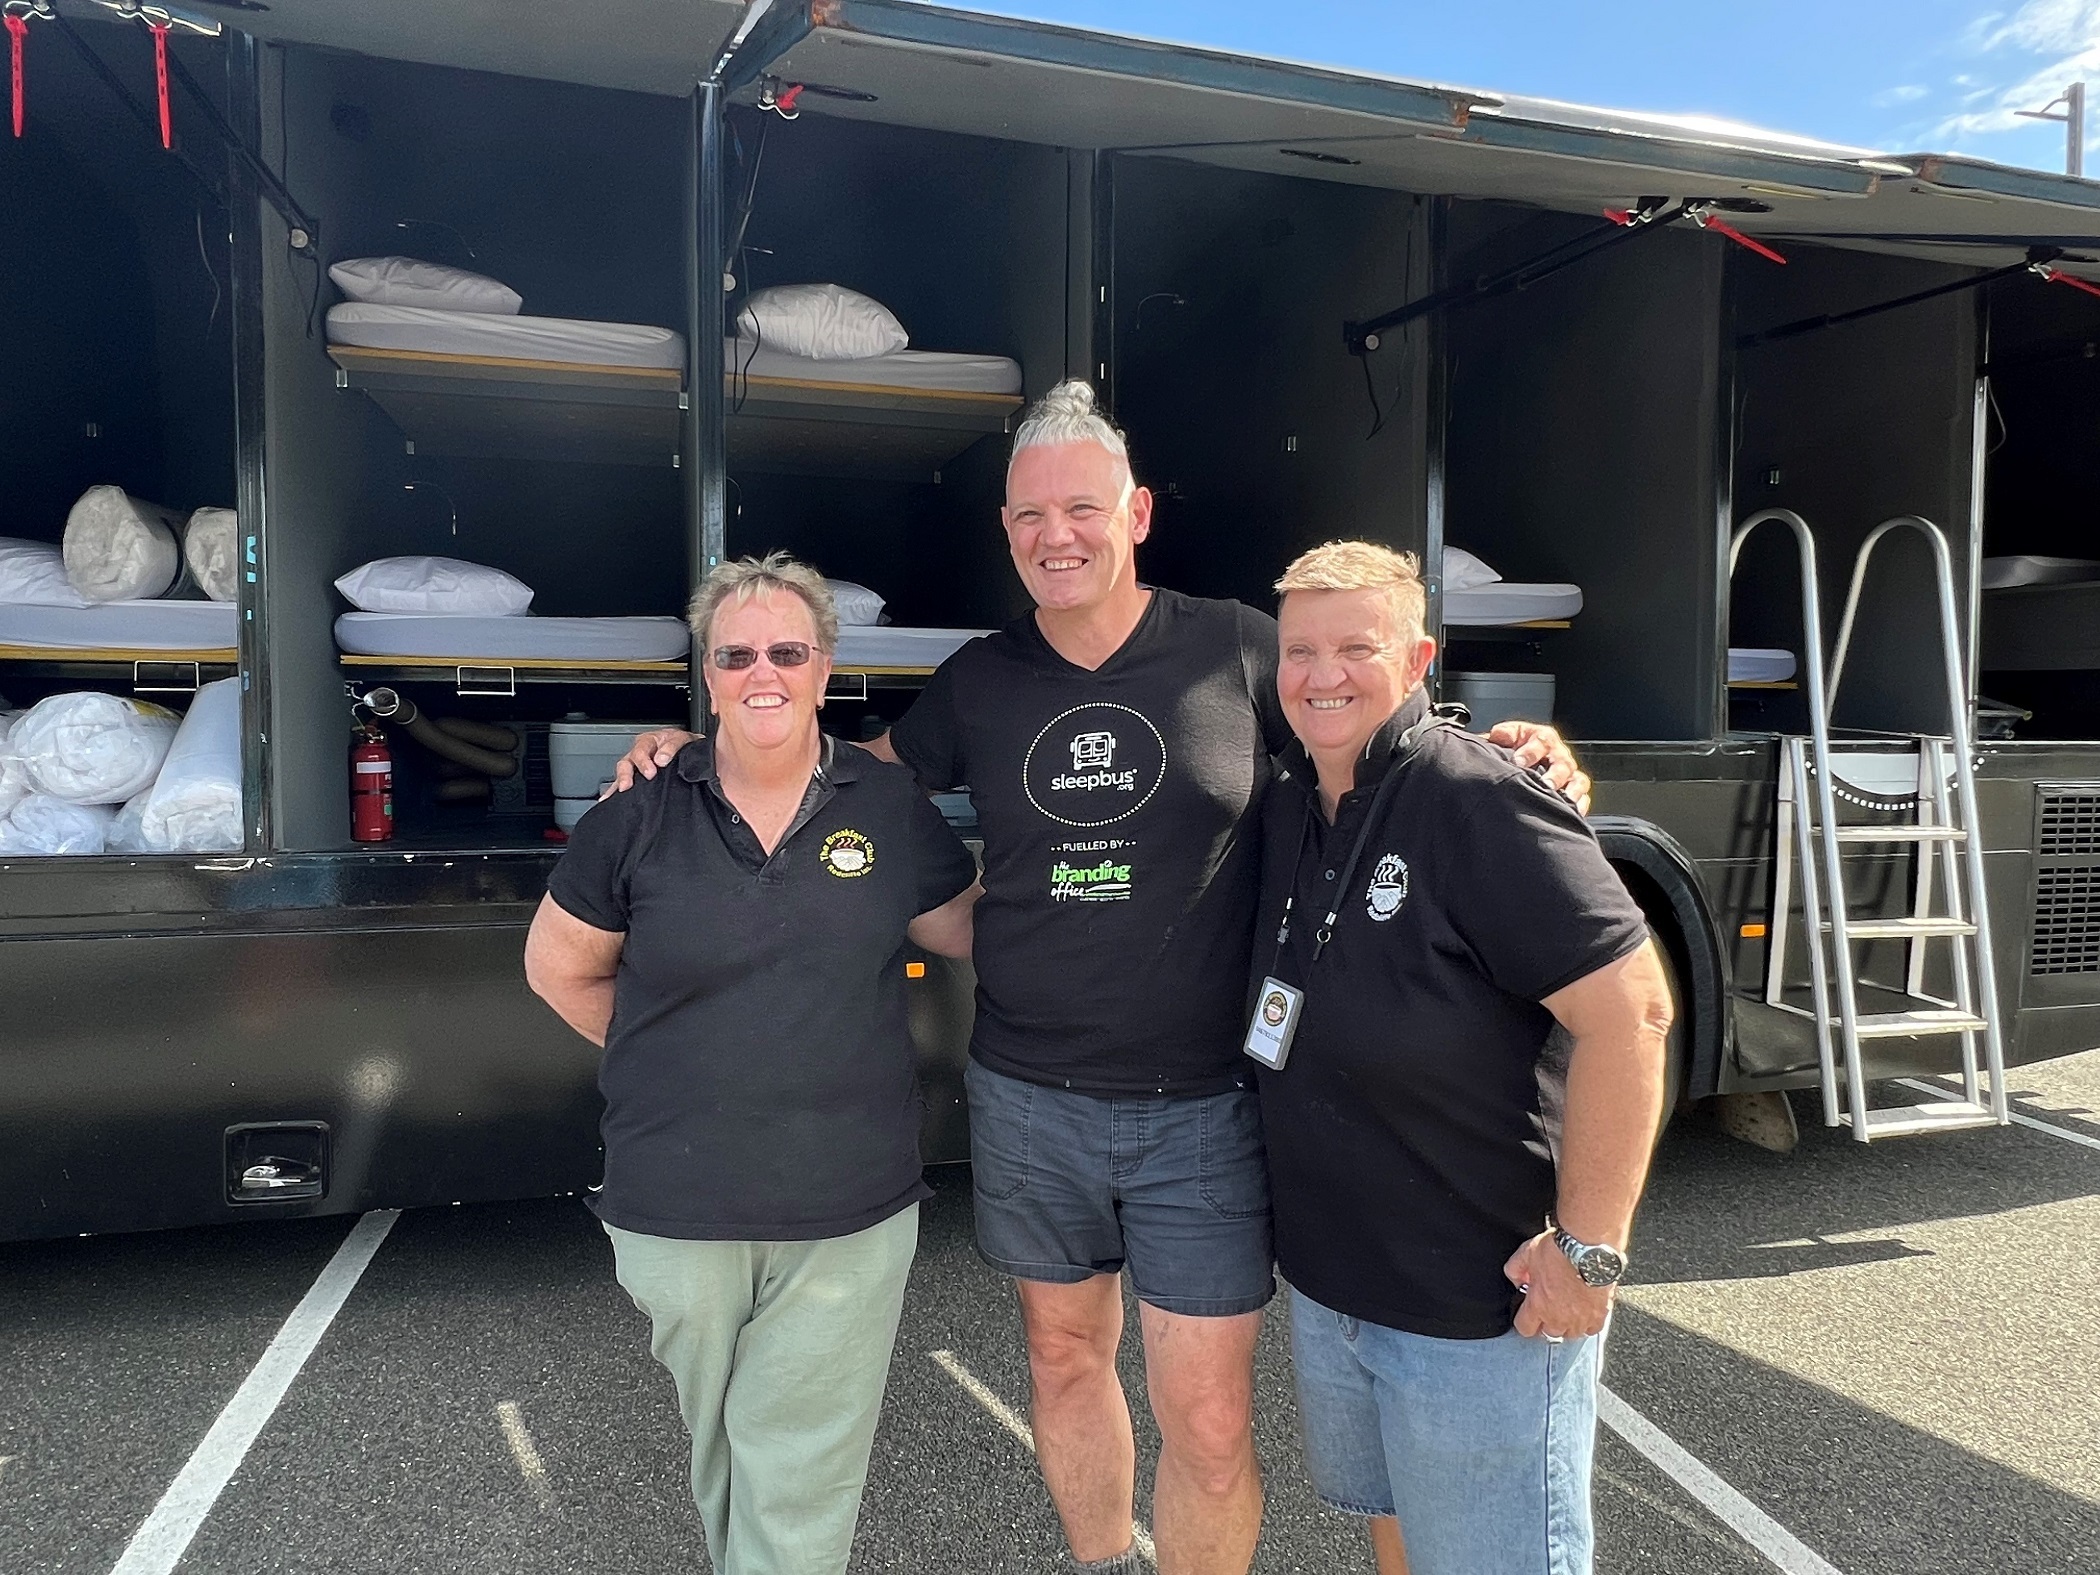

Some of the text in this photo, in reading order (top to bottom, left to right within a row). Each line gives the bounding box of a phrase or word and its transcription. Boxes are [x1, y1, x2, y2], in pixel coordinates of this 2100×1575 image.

[1051, 769, 1134, 791] sleepbus
[1062, 839, 1124, 852] FUELLED BY
[1051, 860, 1132, 882] branding
[1050, 881, 1085, 902] office
